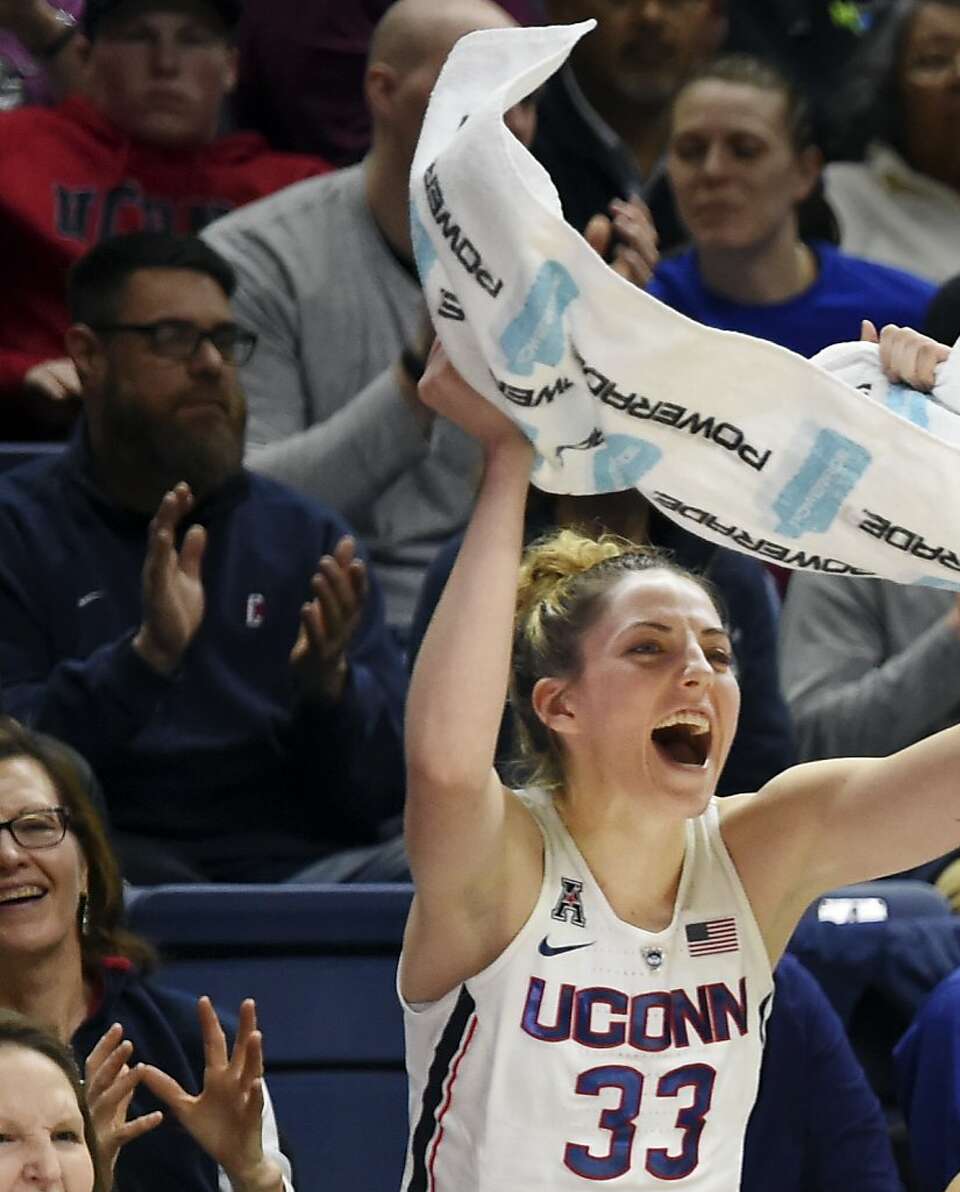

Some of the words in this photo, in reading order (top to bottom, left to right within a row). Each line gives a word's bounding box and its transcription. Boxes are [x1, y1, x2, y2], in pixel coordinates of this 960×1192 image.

[578, 360, 772, 472] POWERAD
[520, 976, 749, 1053] UCONN
[563, 1063, 717, 1181] 33
